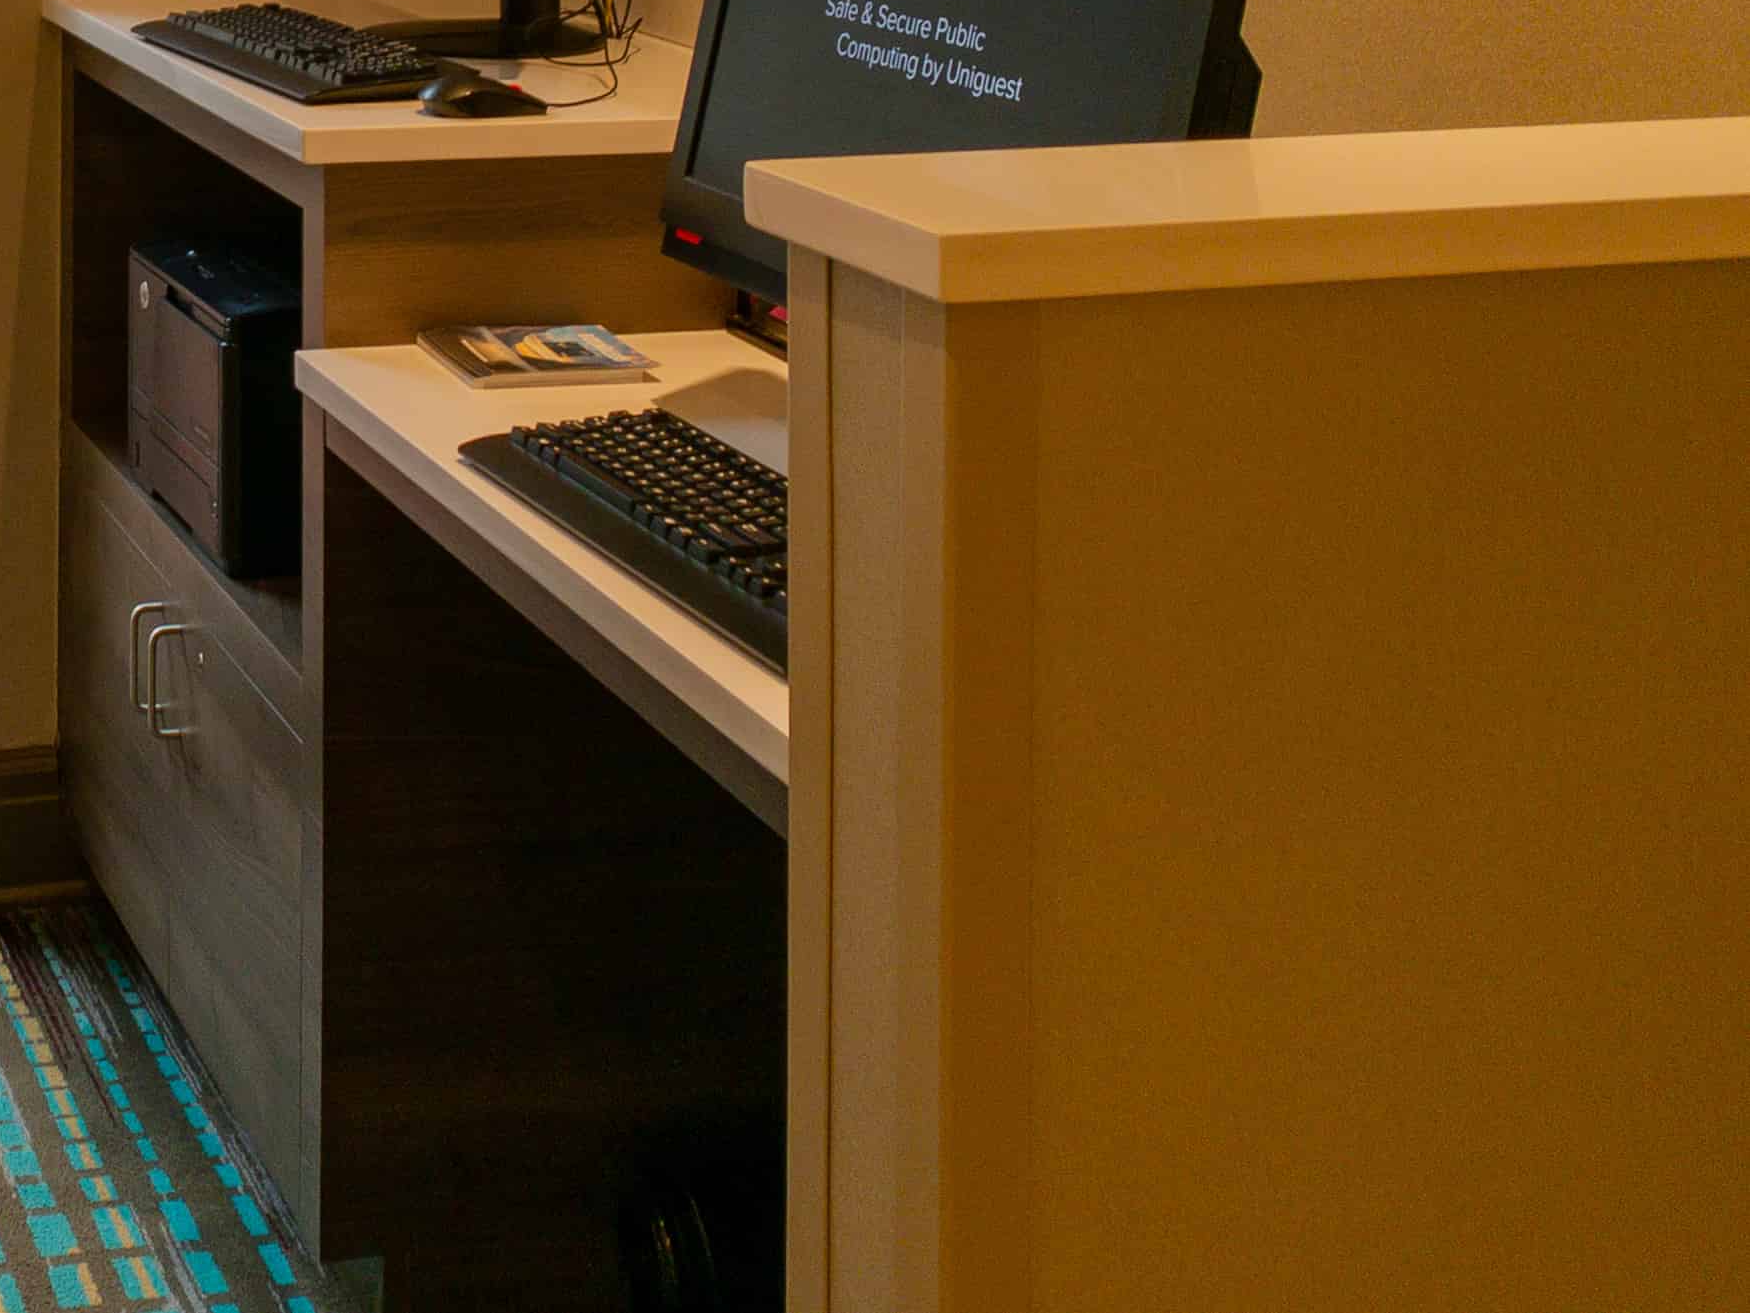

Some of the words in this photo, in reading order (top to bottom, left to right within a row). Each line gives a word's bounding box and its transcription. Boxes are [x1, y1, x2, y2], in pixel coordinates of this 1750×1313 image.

[861, 0, 875, 25] &
[875, 4, 932, 39] Secure
[934, 17, 986, 51] Public
[836, 32, 919, 80] Computing
[921, 53, 945, 86] by
[946, 58, 1024, 102] Uniguest
